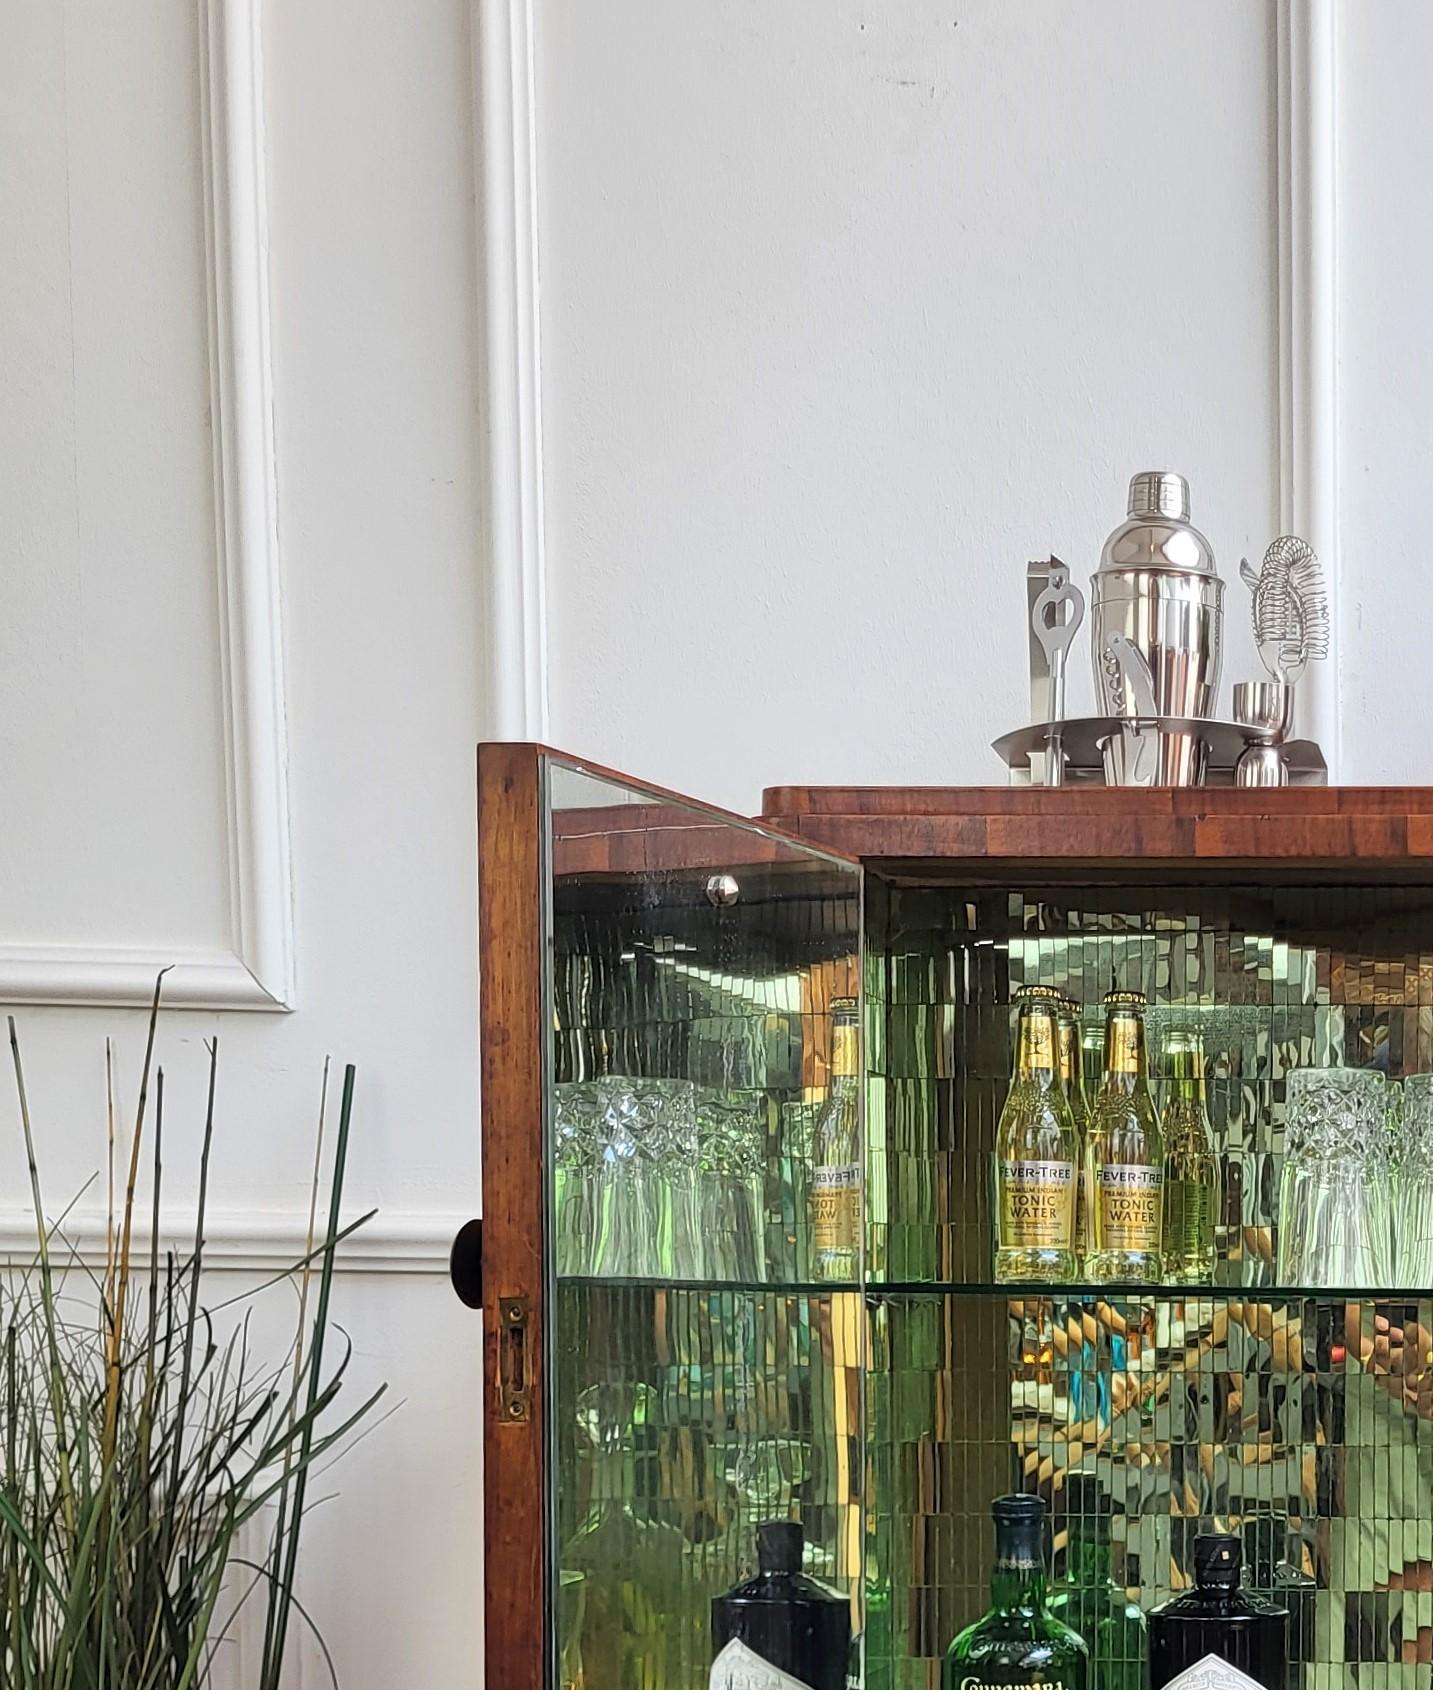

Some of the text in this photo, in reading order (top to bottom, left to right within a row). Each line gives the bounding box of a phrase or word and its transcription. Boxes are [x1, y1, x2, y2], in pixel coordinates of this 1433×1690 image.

[1000, 1166, 1071, 1179] FEVER-TREE
[1012, 1195, 1056, 1206] TONIC
[1112, 1199, 1154, 1210] TONIC
[1011, 1207, 1057, 1218] WATER
[1110, 1210, 1155, 1223] WATER
